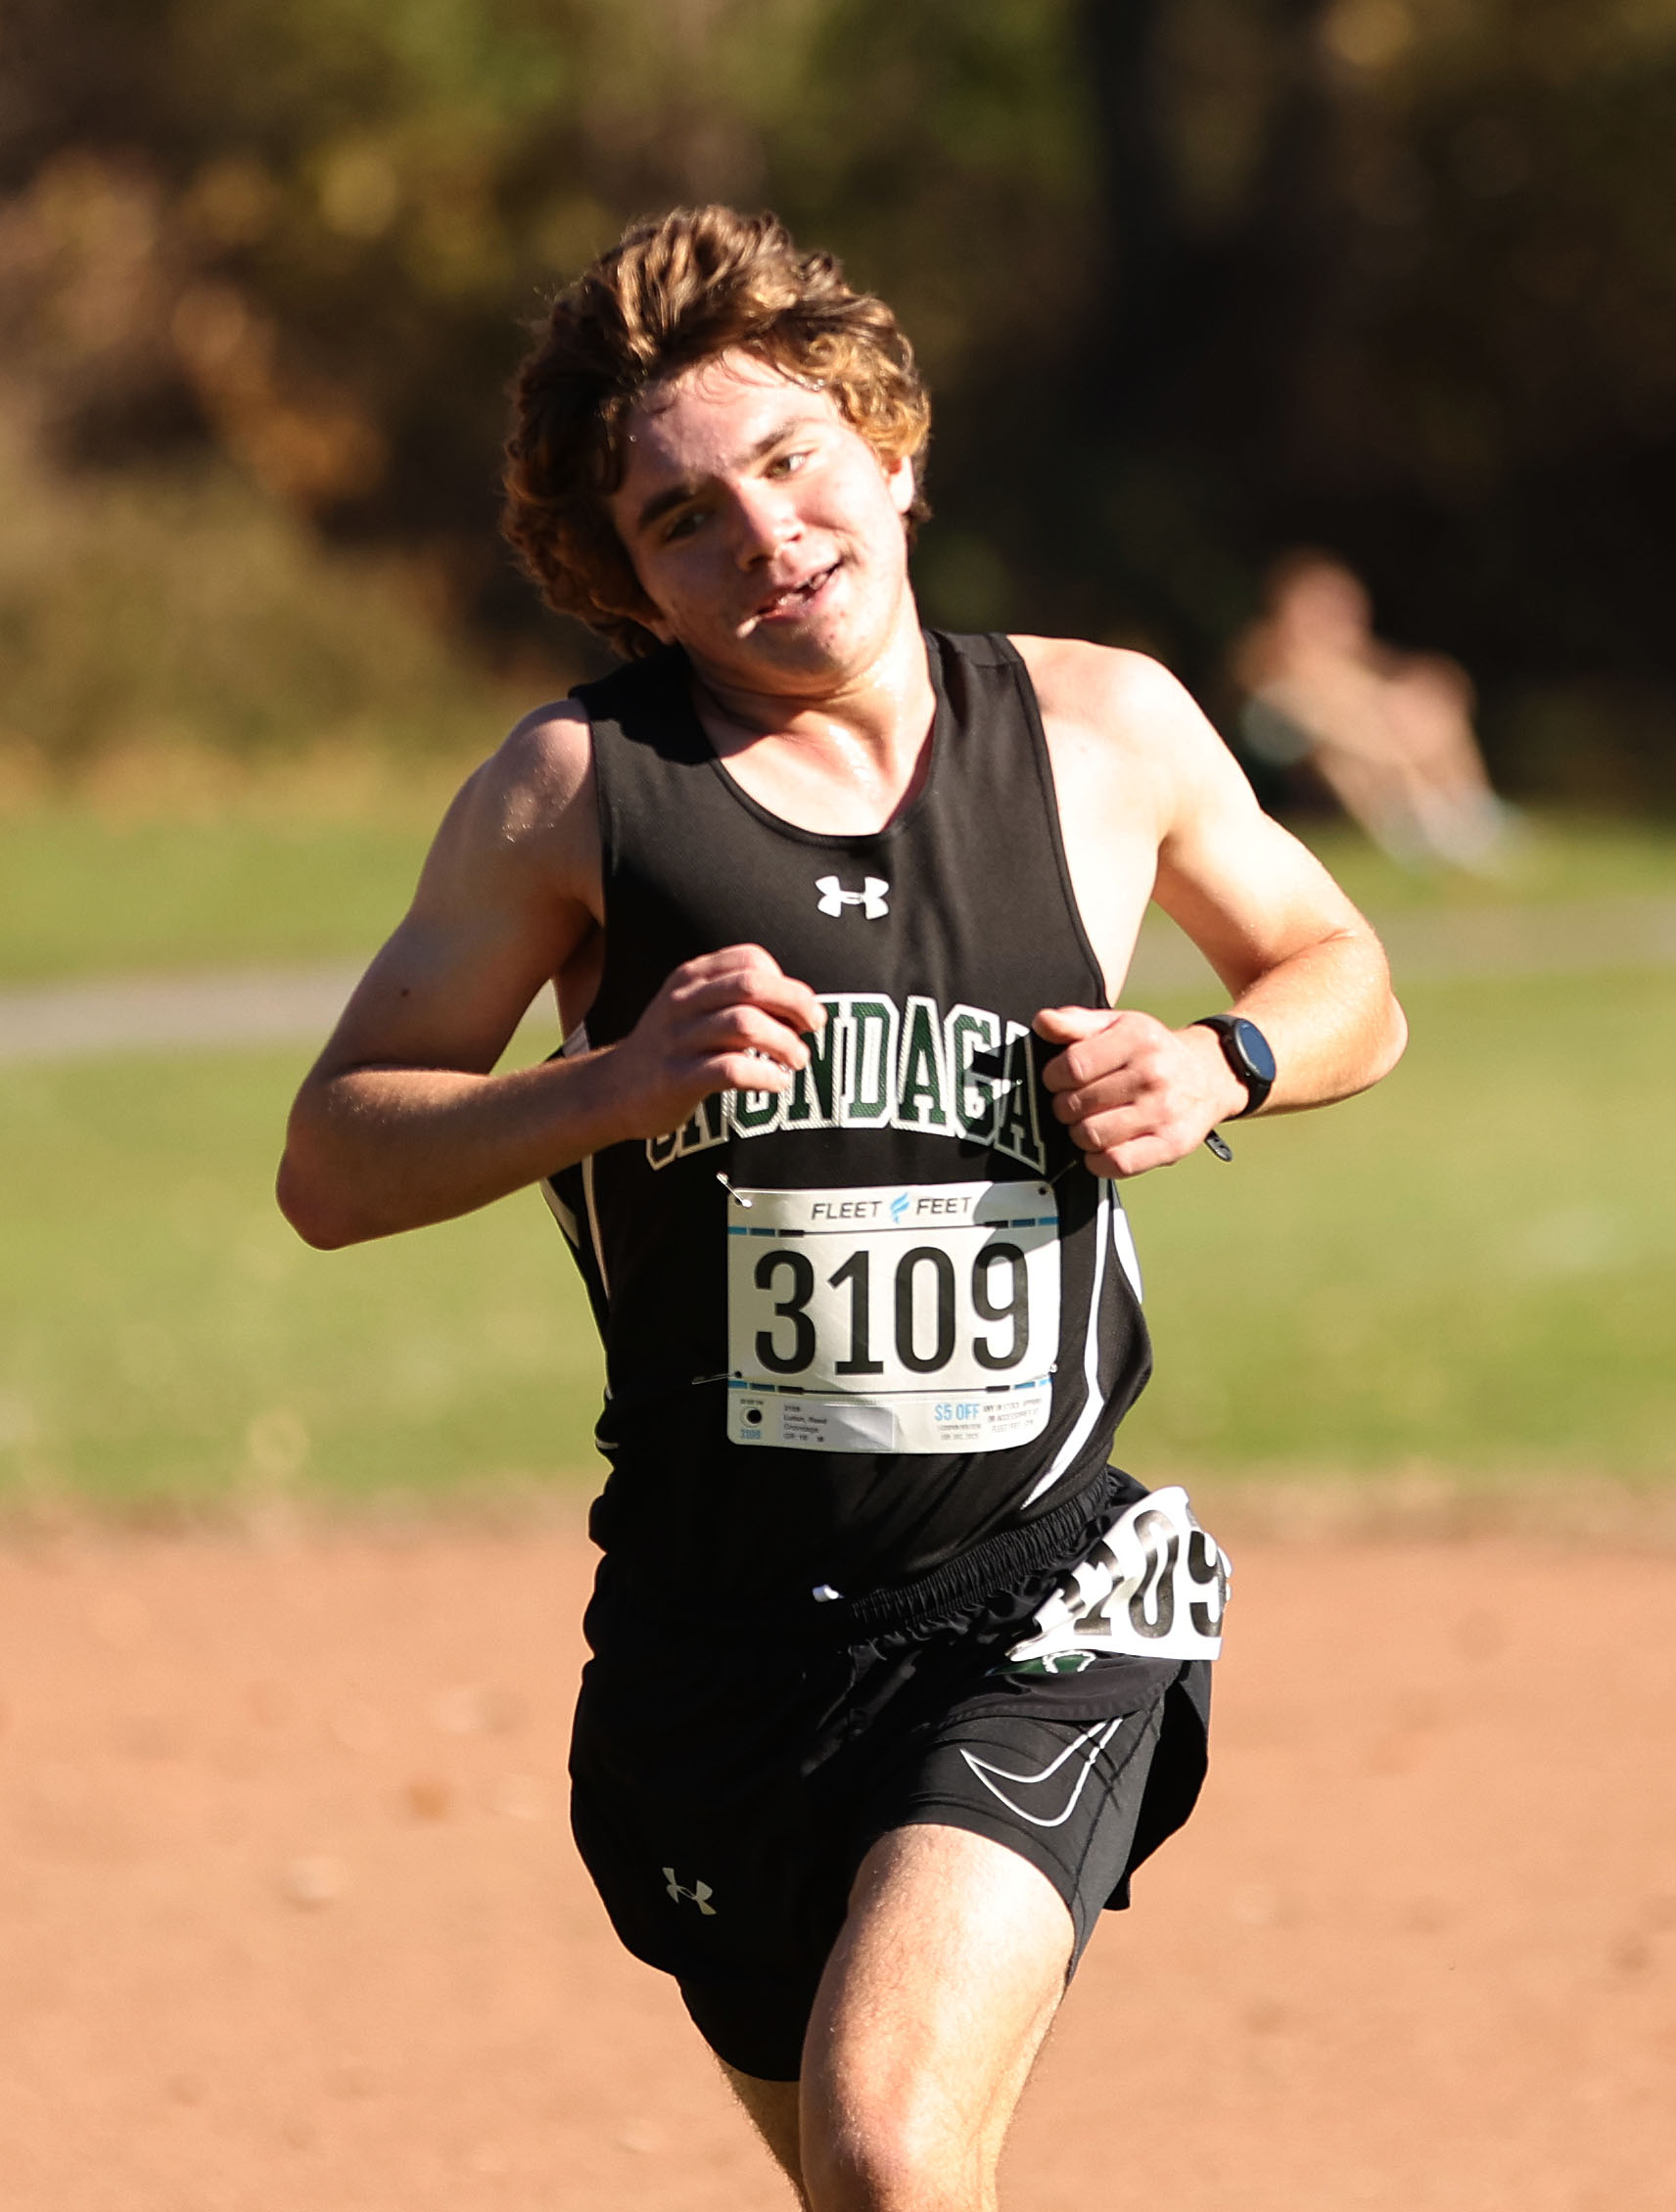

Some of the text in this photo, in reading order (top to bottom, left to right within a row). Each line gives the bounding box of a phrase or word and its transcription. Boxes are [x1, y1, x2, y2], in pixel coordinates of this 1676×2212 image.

[811, 1197, 972, 1221] FLEET FEET
[754, 1242, 1029, 1375] 3109
[934, 1404, 953, 1421] $5
[955, 1403, 980, 1420] OFF
